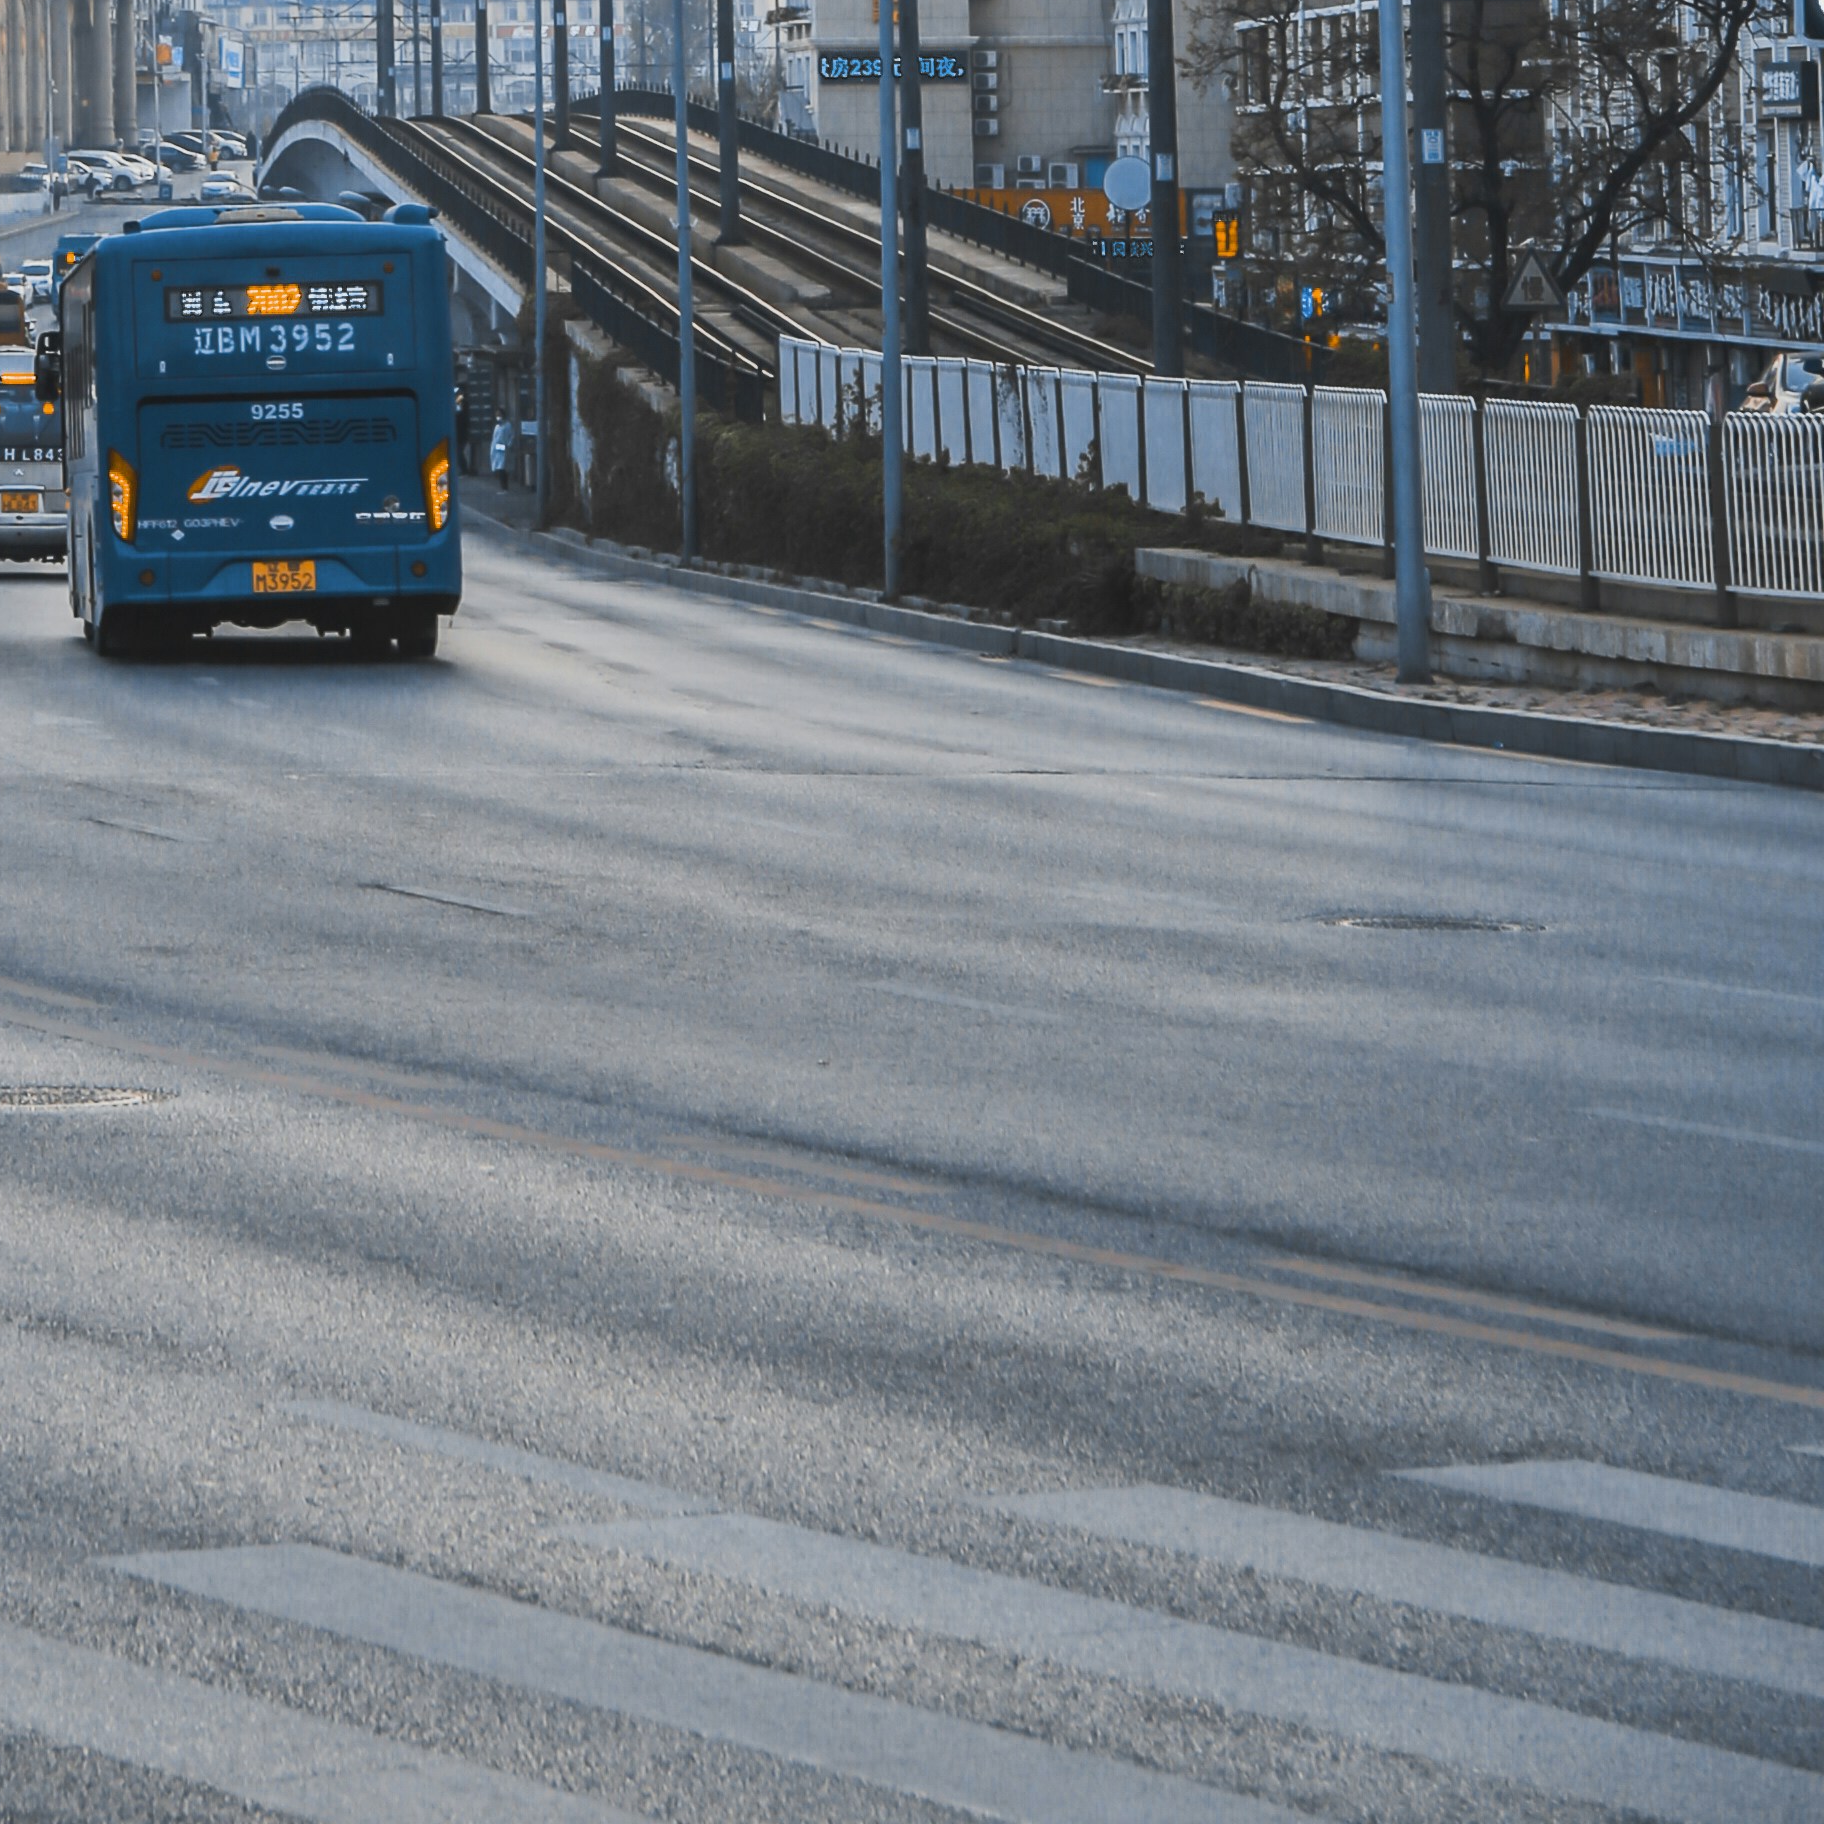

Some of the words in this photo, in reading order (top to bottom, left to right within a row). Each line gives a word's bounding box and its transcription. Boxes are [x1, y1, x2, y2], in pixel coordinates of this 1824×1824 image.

[1070, 197, 1085, 230] 北京
[251, 403, 304, 420] 9255
[255, 572, 314, 591] M3952
